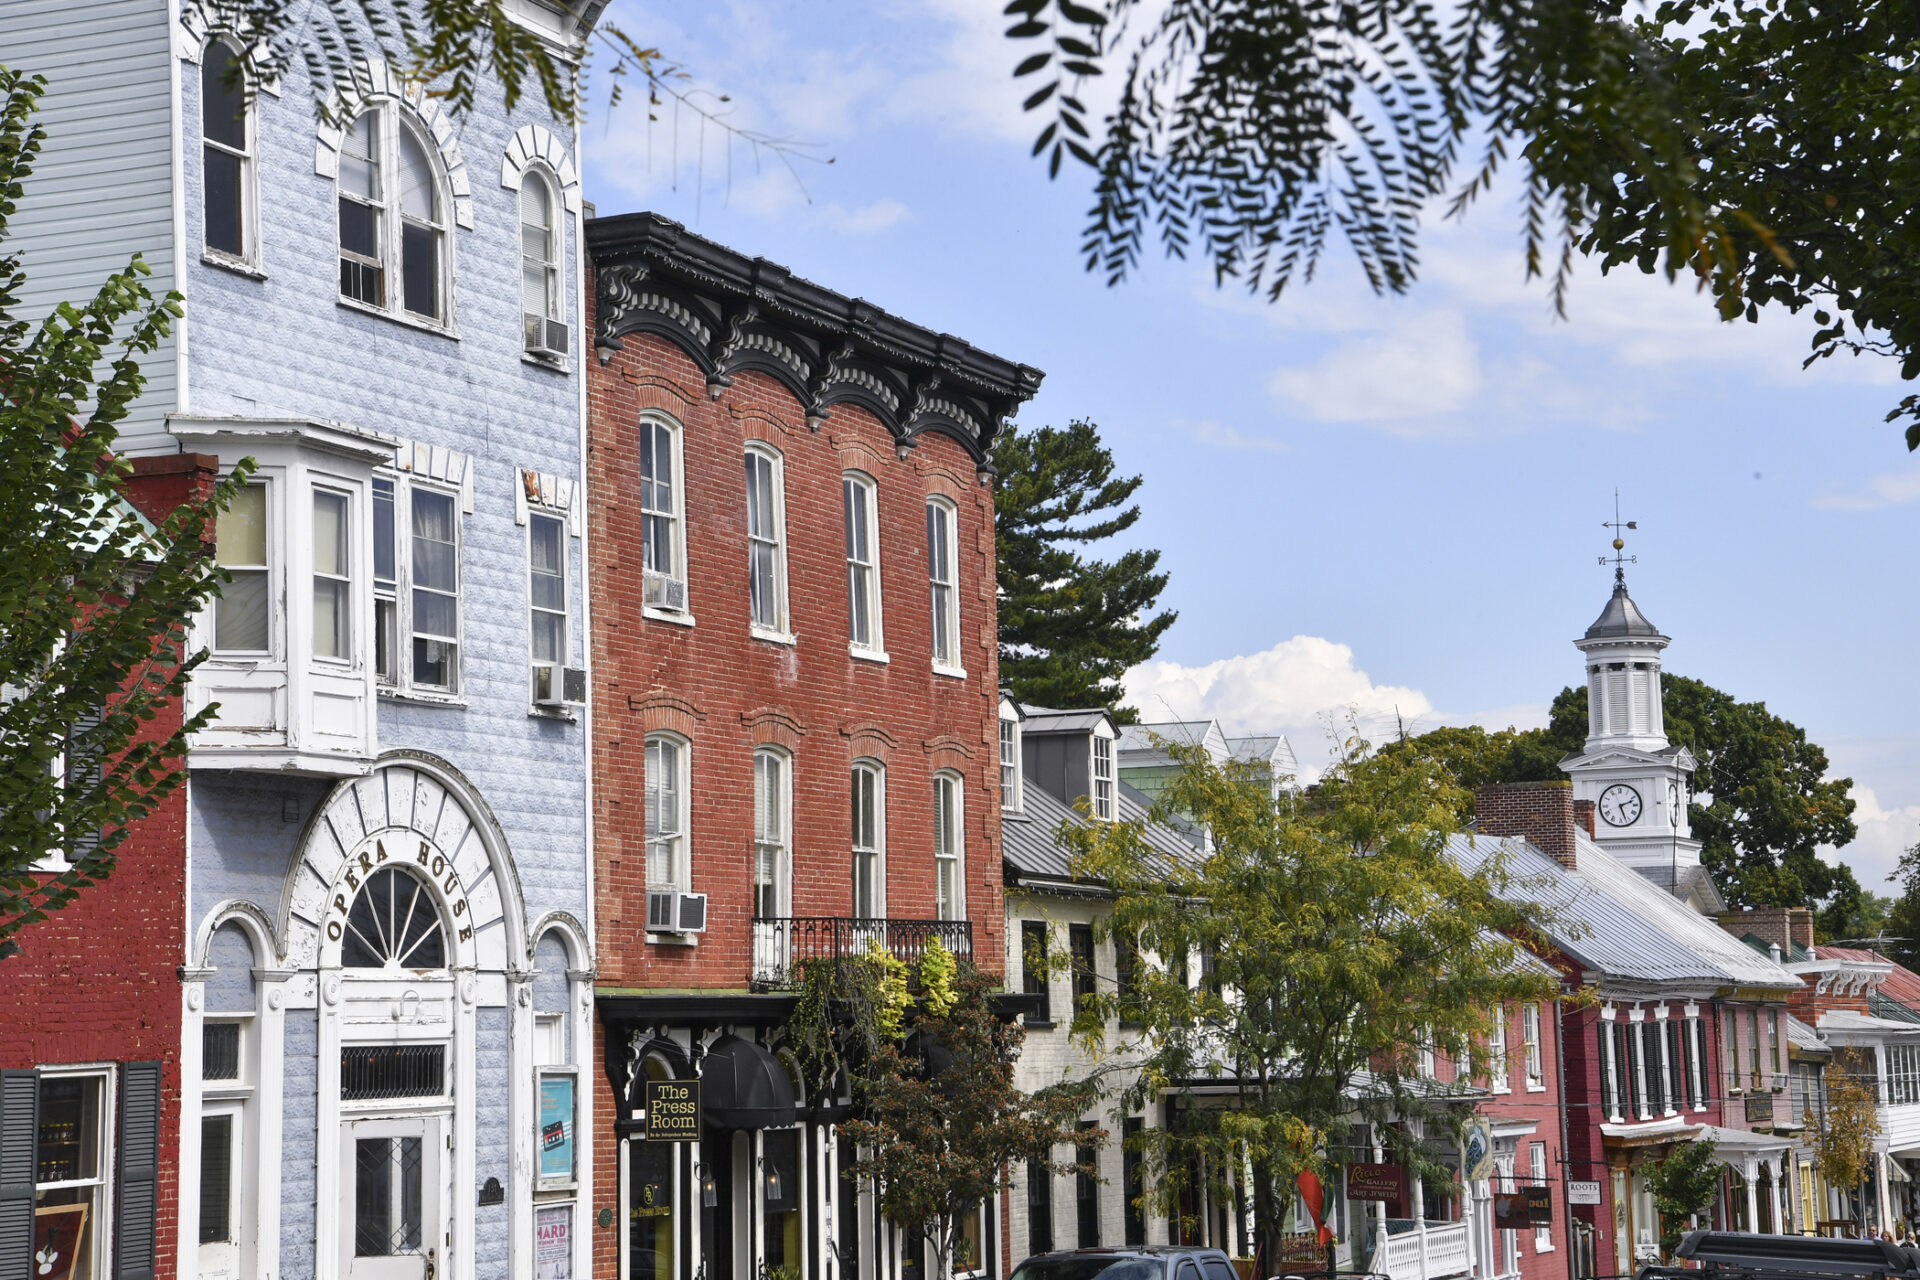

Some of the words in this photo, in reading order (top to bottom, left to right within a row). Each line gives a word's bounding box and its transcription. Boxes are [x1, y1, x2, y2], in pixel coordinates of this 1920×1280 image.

[327, 838, 388, 942] OPERA
[417, 840, 473, 944] HOUSE
[658, 1085, 689, 1099] The
[651, 1100, 696, 1114] Press
[651, 1114, 696, 1129] Room
[537, 1223, 567, 1240] HARD
